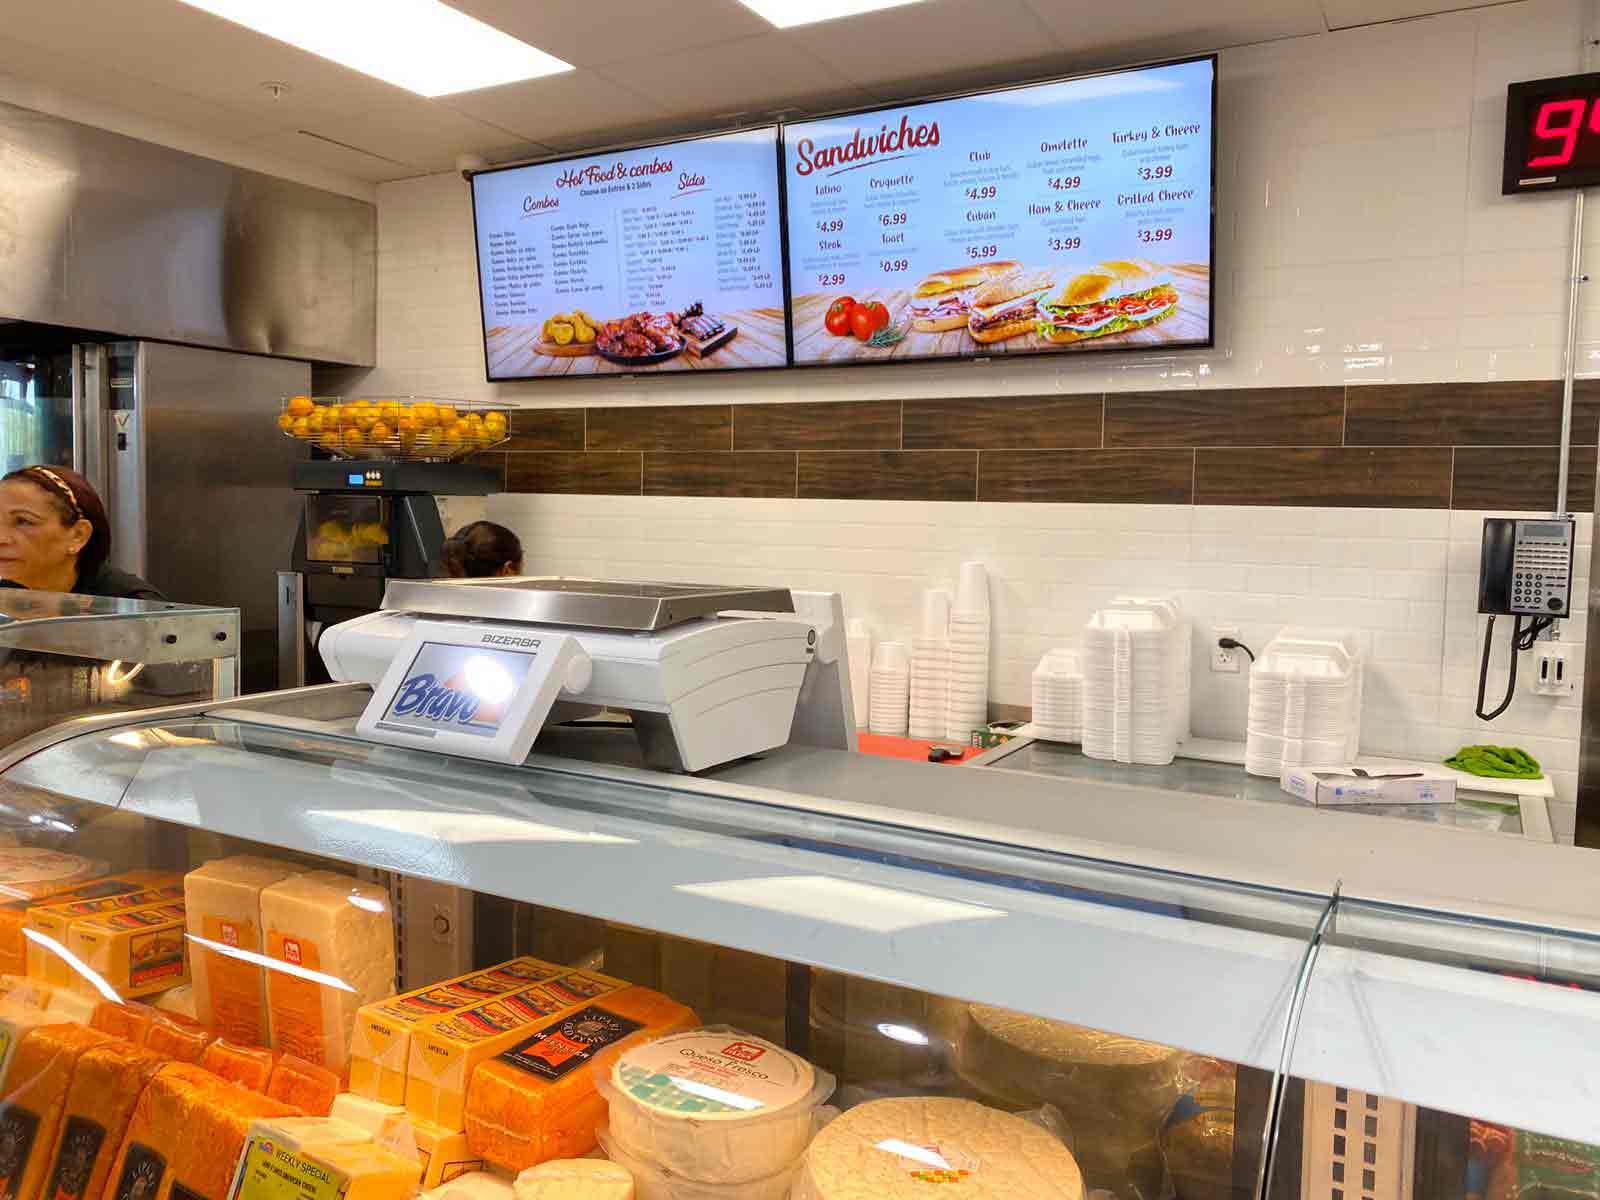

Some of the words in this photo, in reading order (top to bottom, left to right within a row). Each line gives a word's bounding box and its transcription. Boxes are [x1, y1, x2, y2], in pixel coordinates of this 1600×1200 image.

[1112, 130, 1148, 145] Turkey
[1151, 126, 1161, 139] &
[1165, 123, 1200, 137] Cheese
[1527, 98, 1600, 167] 9
[796, 114, 940, 176] Sandwiches
[1041, 138, 1088, 153] Omelette
[969, 150, 992, 162] Club
[556, 167, 584, 189] Hot
[585, 164, 616, 184] Food
[617, 161, 628, 179] &
[629, 156, 673, 178] combos
[1137, 165, 1173, 181] $3.99
[677, 172, 706, 191] Sides
[869, 174, 914, 190] Croquette
[1047, 176, 1081, 190] $4.99
[815, 183, 842, 196] Latino
[965, 185, 997, 200] $4.99
[1117, 191, 1154, 206] Grilled
[1158, 188, 1194, 202] Cheese
[522, 195, 560, 213] Combos
[1028, 203, 1051, 216] Ham
[1055, 201, 1064, 213] &
[1067, 199, 1101, 212] Cheese
[878, 212, 907, 226] $6.99
[966, 209, 996, 222] Cuban
[816, 219, 844, 233] $4.99
[1137, 228, 1173, 242] $3.99
[966, 244, 997, 259] $5.99
[1047, 237, 1081, 251] $3.99
[879, 259, 908, 273] $0.99
[818, 273, 846, 287] $2.99
[481, 633, 542, 649] BIZERBA
[680, 1048, 723, 1065] Queso
[724, 1060, 769, 1080] Fresco
[275, 1151, 301, 1169] WEEKLY
[301, 1162, 331, 1185] SPECIAL
